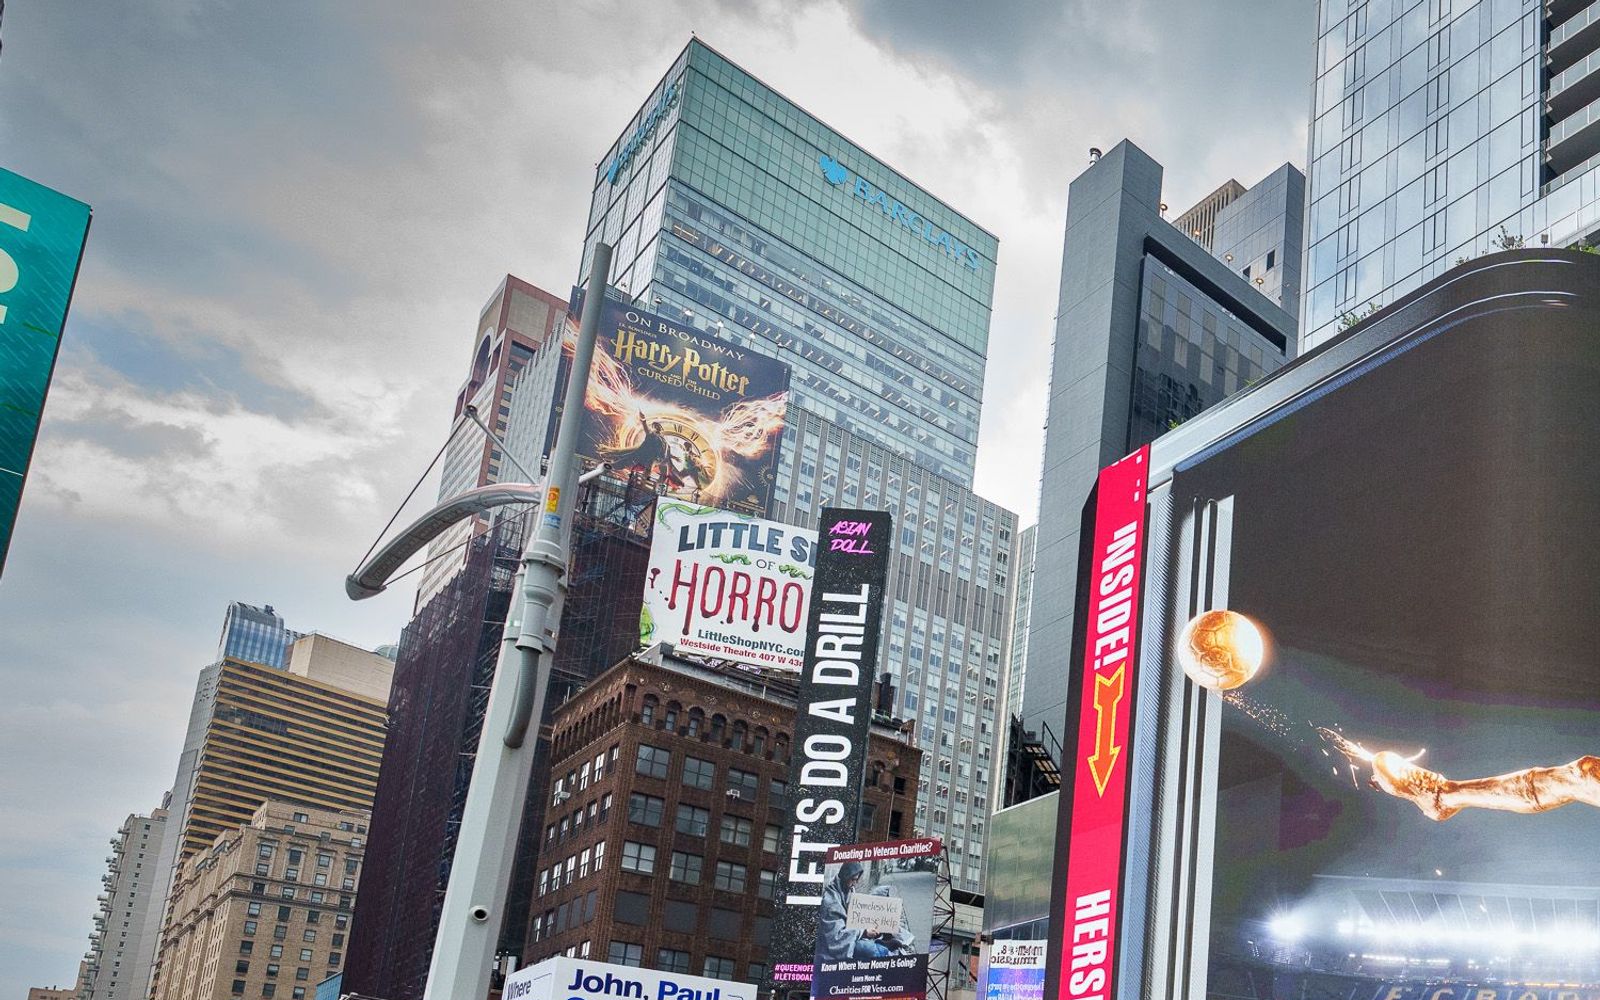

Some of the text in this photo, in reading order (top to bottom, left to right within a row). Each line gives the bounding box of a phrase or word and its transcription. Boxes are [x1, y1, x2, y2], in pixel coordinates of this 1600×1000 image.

[854, 176, 981, 271] BARCLAYS
[625, 311, 745, 361] ON BROADWAY
[611, 329, 749, 396] Harry Potter
[638, 366, 721, 400] CURSED CHILD
[678, 522, 784, 555] LITTLE
[829, 520, 873, 536] ASIAN
[831, 538, 875, 554] DOLL
[756, 559, 775, 571] OF
[1094, 520, 1137, 670] INSIDE!
[812, 583, 870, 686] DRILL
[680, 638, 722, 654] Westside
[723, 645, 757, 660] Theatre
[759, 651, 776, 663] 407
[777, 655, 790, 664] W
[808, 698, 857, 725] A
[801, 733, 852, 787] DO
[833, 841, 933, 861] Donating to Veteran Charities?
[852, 911, 898, 928] Please Help
[821, 961, 837, 972] Know
[838, 961, 857, 971] Where
[857, 960, 870, 970] Your
[870, 959, 890, 970] Money
[897, 957, 917, 969] Going?
[507, 979, 531, 1000] Where
